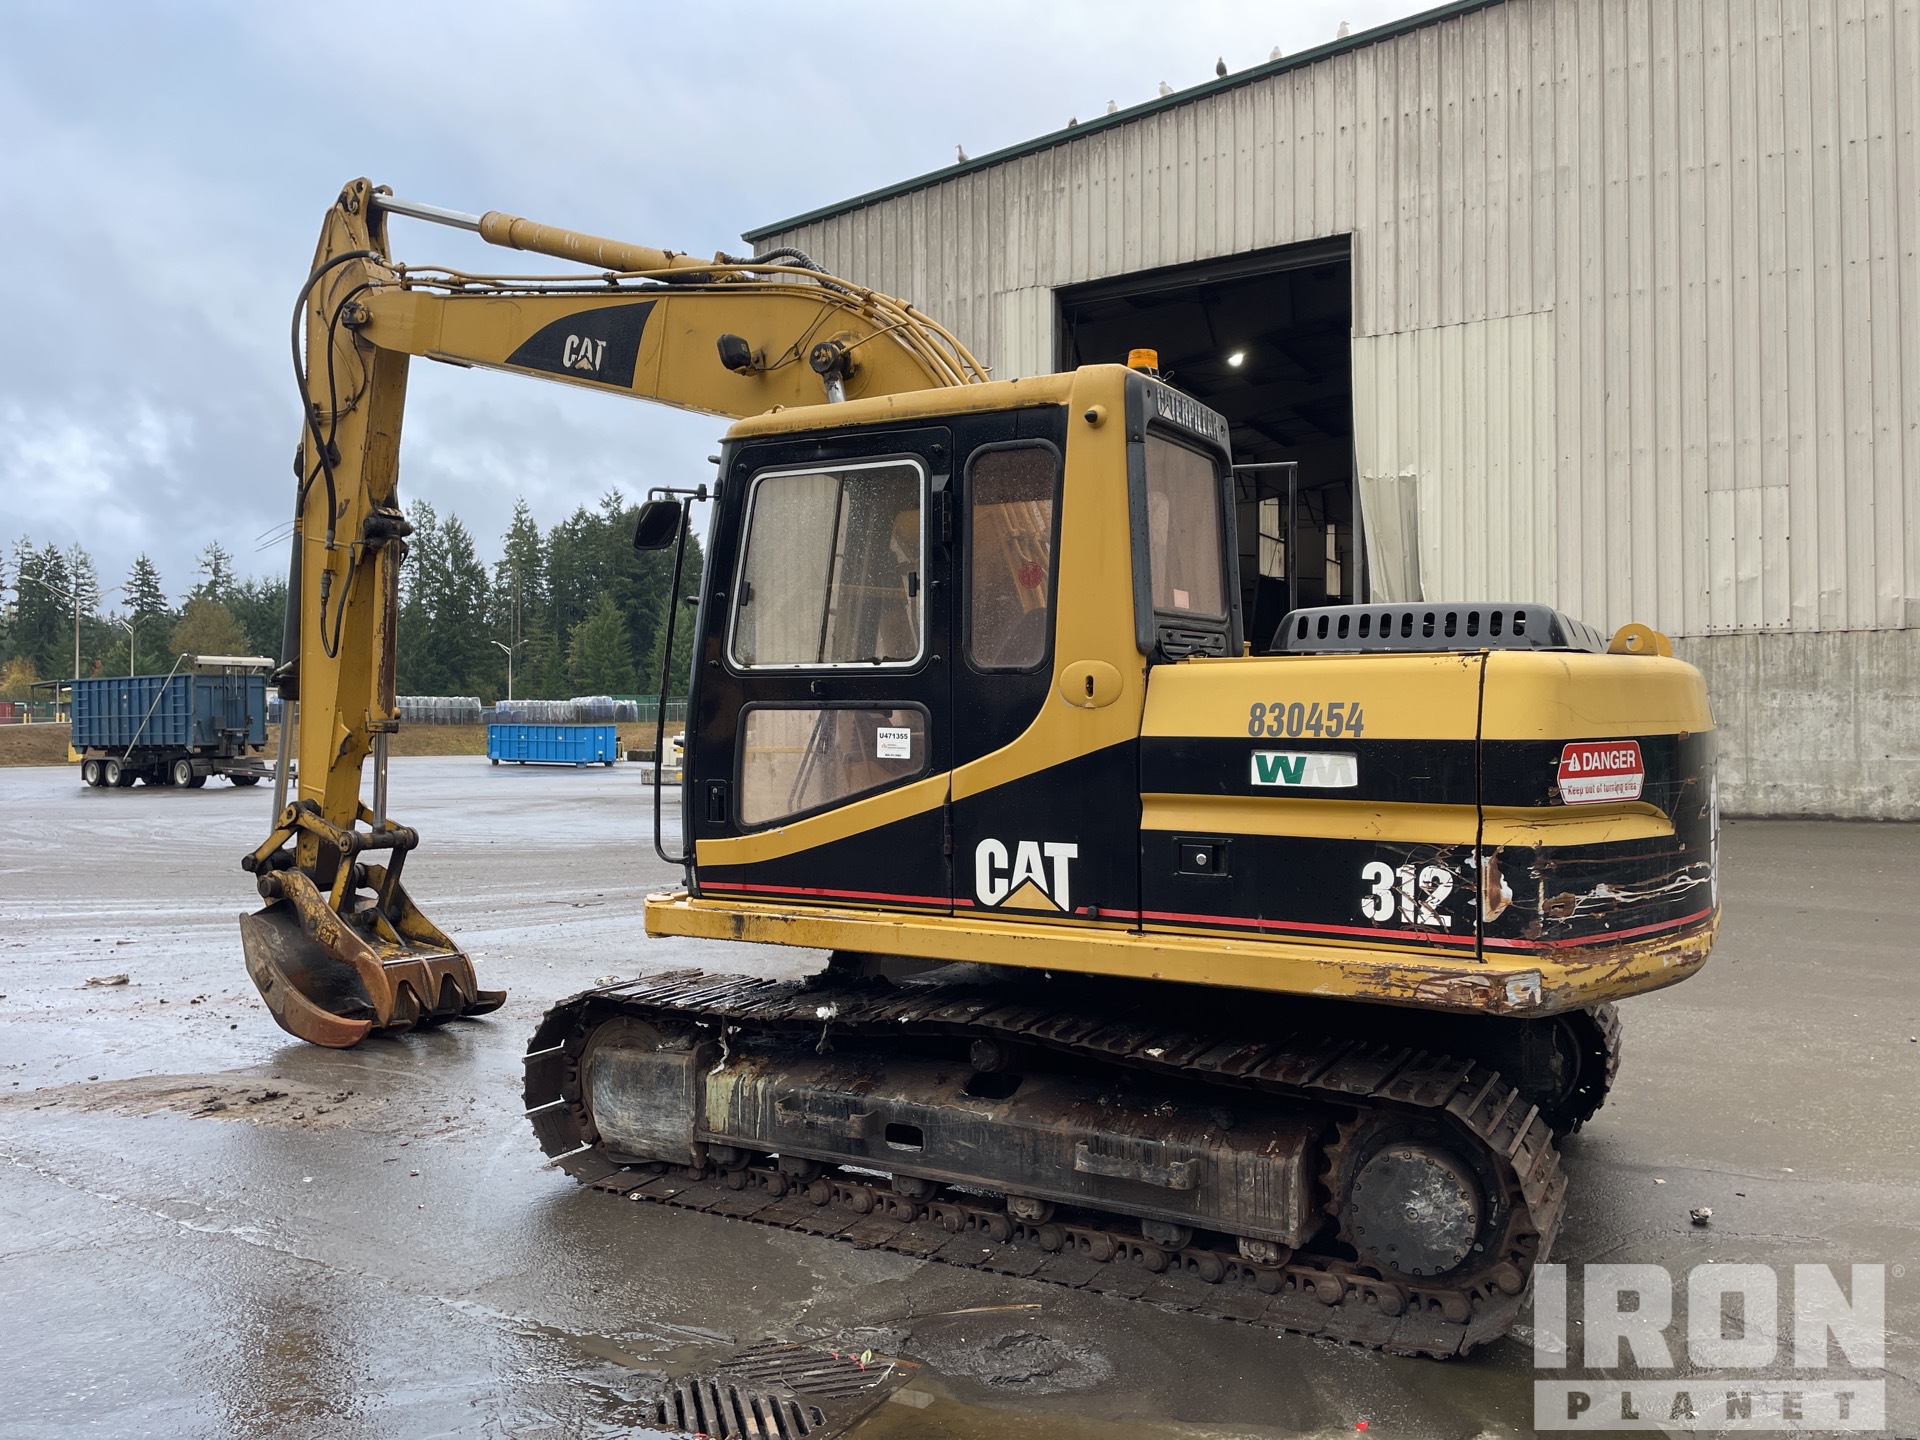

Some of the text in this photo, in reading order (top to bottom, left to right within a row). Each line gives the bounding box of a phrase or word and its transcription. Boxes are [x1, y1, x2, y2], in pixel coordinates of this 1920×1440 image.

[563, 334, 607, 371] CAT
[1157, 386, 1220, 442] CATERPILLAR
[879, 732, 908, 740] U471355
[1248, 702, 1364, 738] 830454
[1255, 754, 1354, 786] WM
[1583, 750, 1636, 770] DANGER
[1567, 782, 1637, 796] Keep out of turning area
[975, 838, 1079, 912] CAT
[1361, 861, 1453, 927] 312
